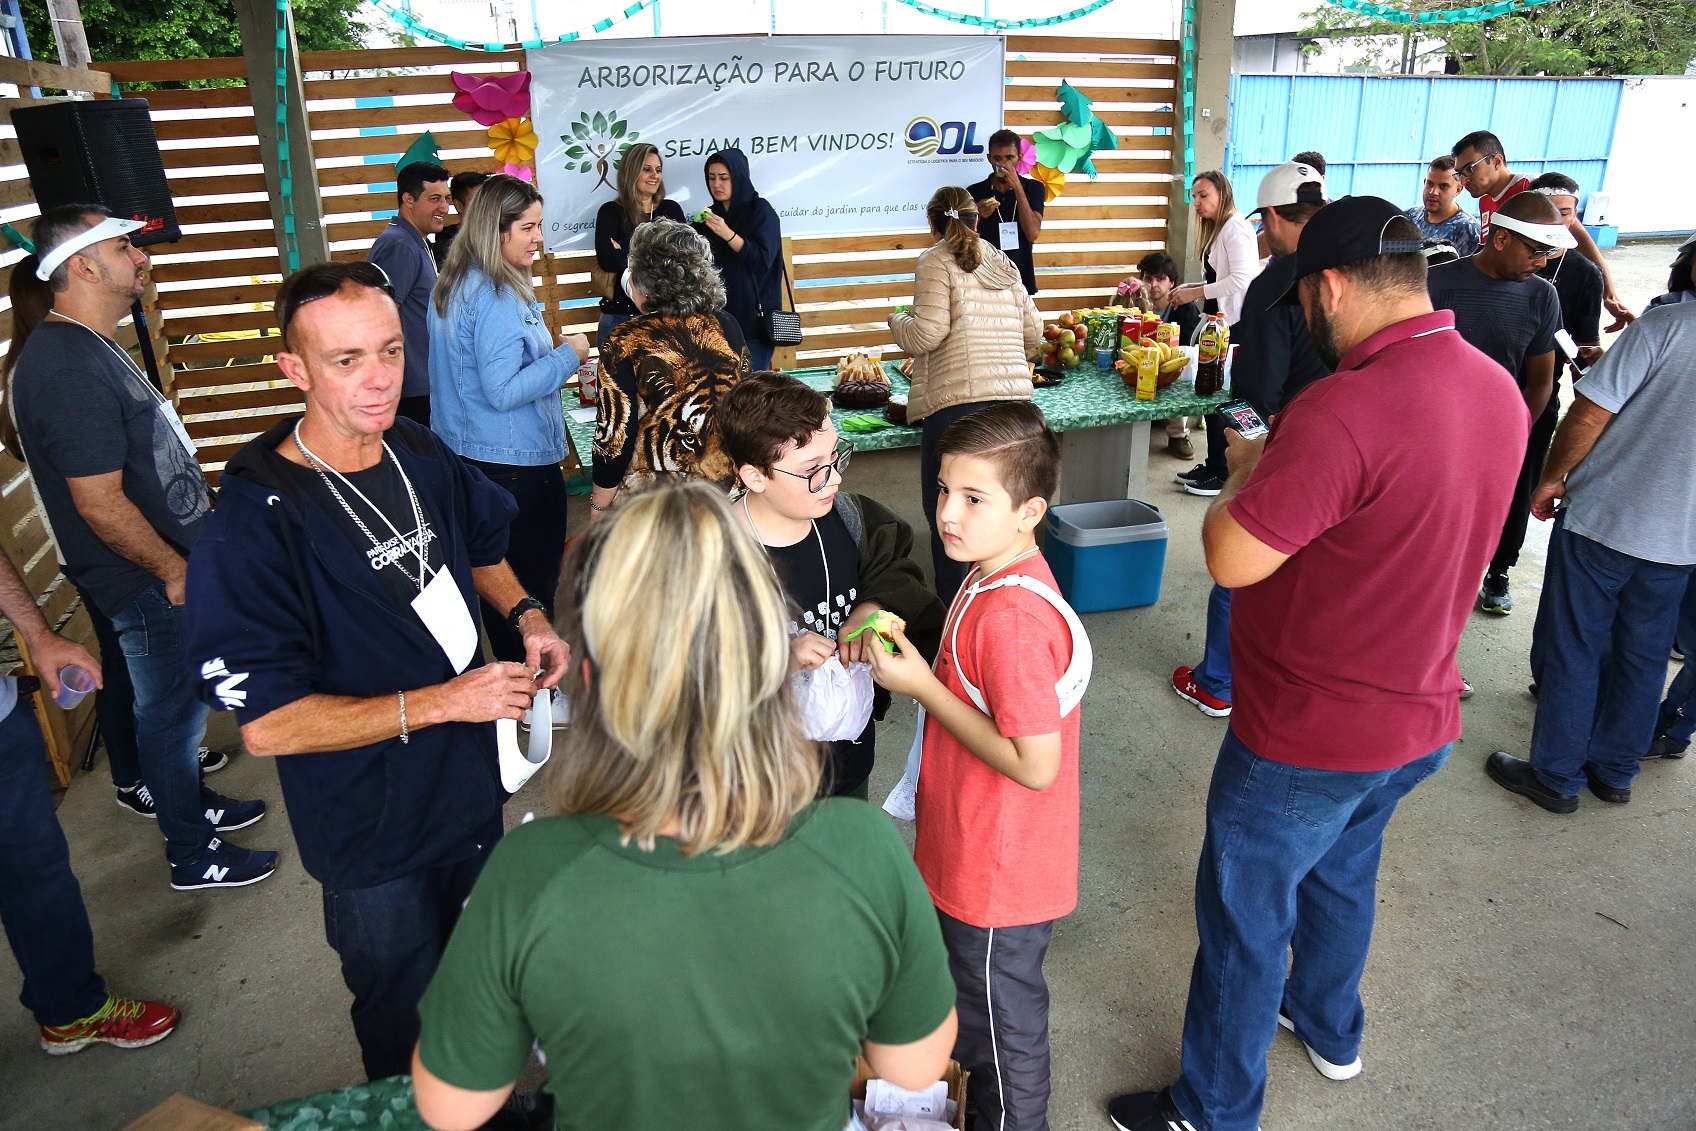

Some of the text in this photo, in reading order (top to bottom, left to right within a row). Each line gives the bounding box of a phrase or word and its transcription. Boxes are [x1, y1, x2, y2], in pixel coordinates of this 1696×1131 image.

[578, 55, 966, 91] ARBORIZAÇÃO PARA O FUTURO
[665, 132, 894, 157] SEJAM BEM VINDOS!
[780, 207, 809, 218] cuidar
[812, 206, 823, 216] do
[826, 204, 857, 217] jardim
[860, 206, 881, 216] para
[884, 204, 899, 215] que
[902, 202, 918, 211] elas
[552, 219, 595, 233] O segred
